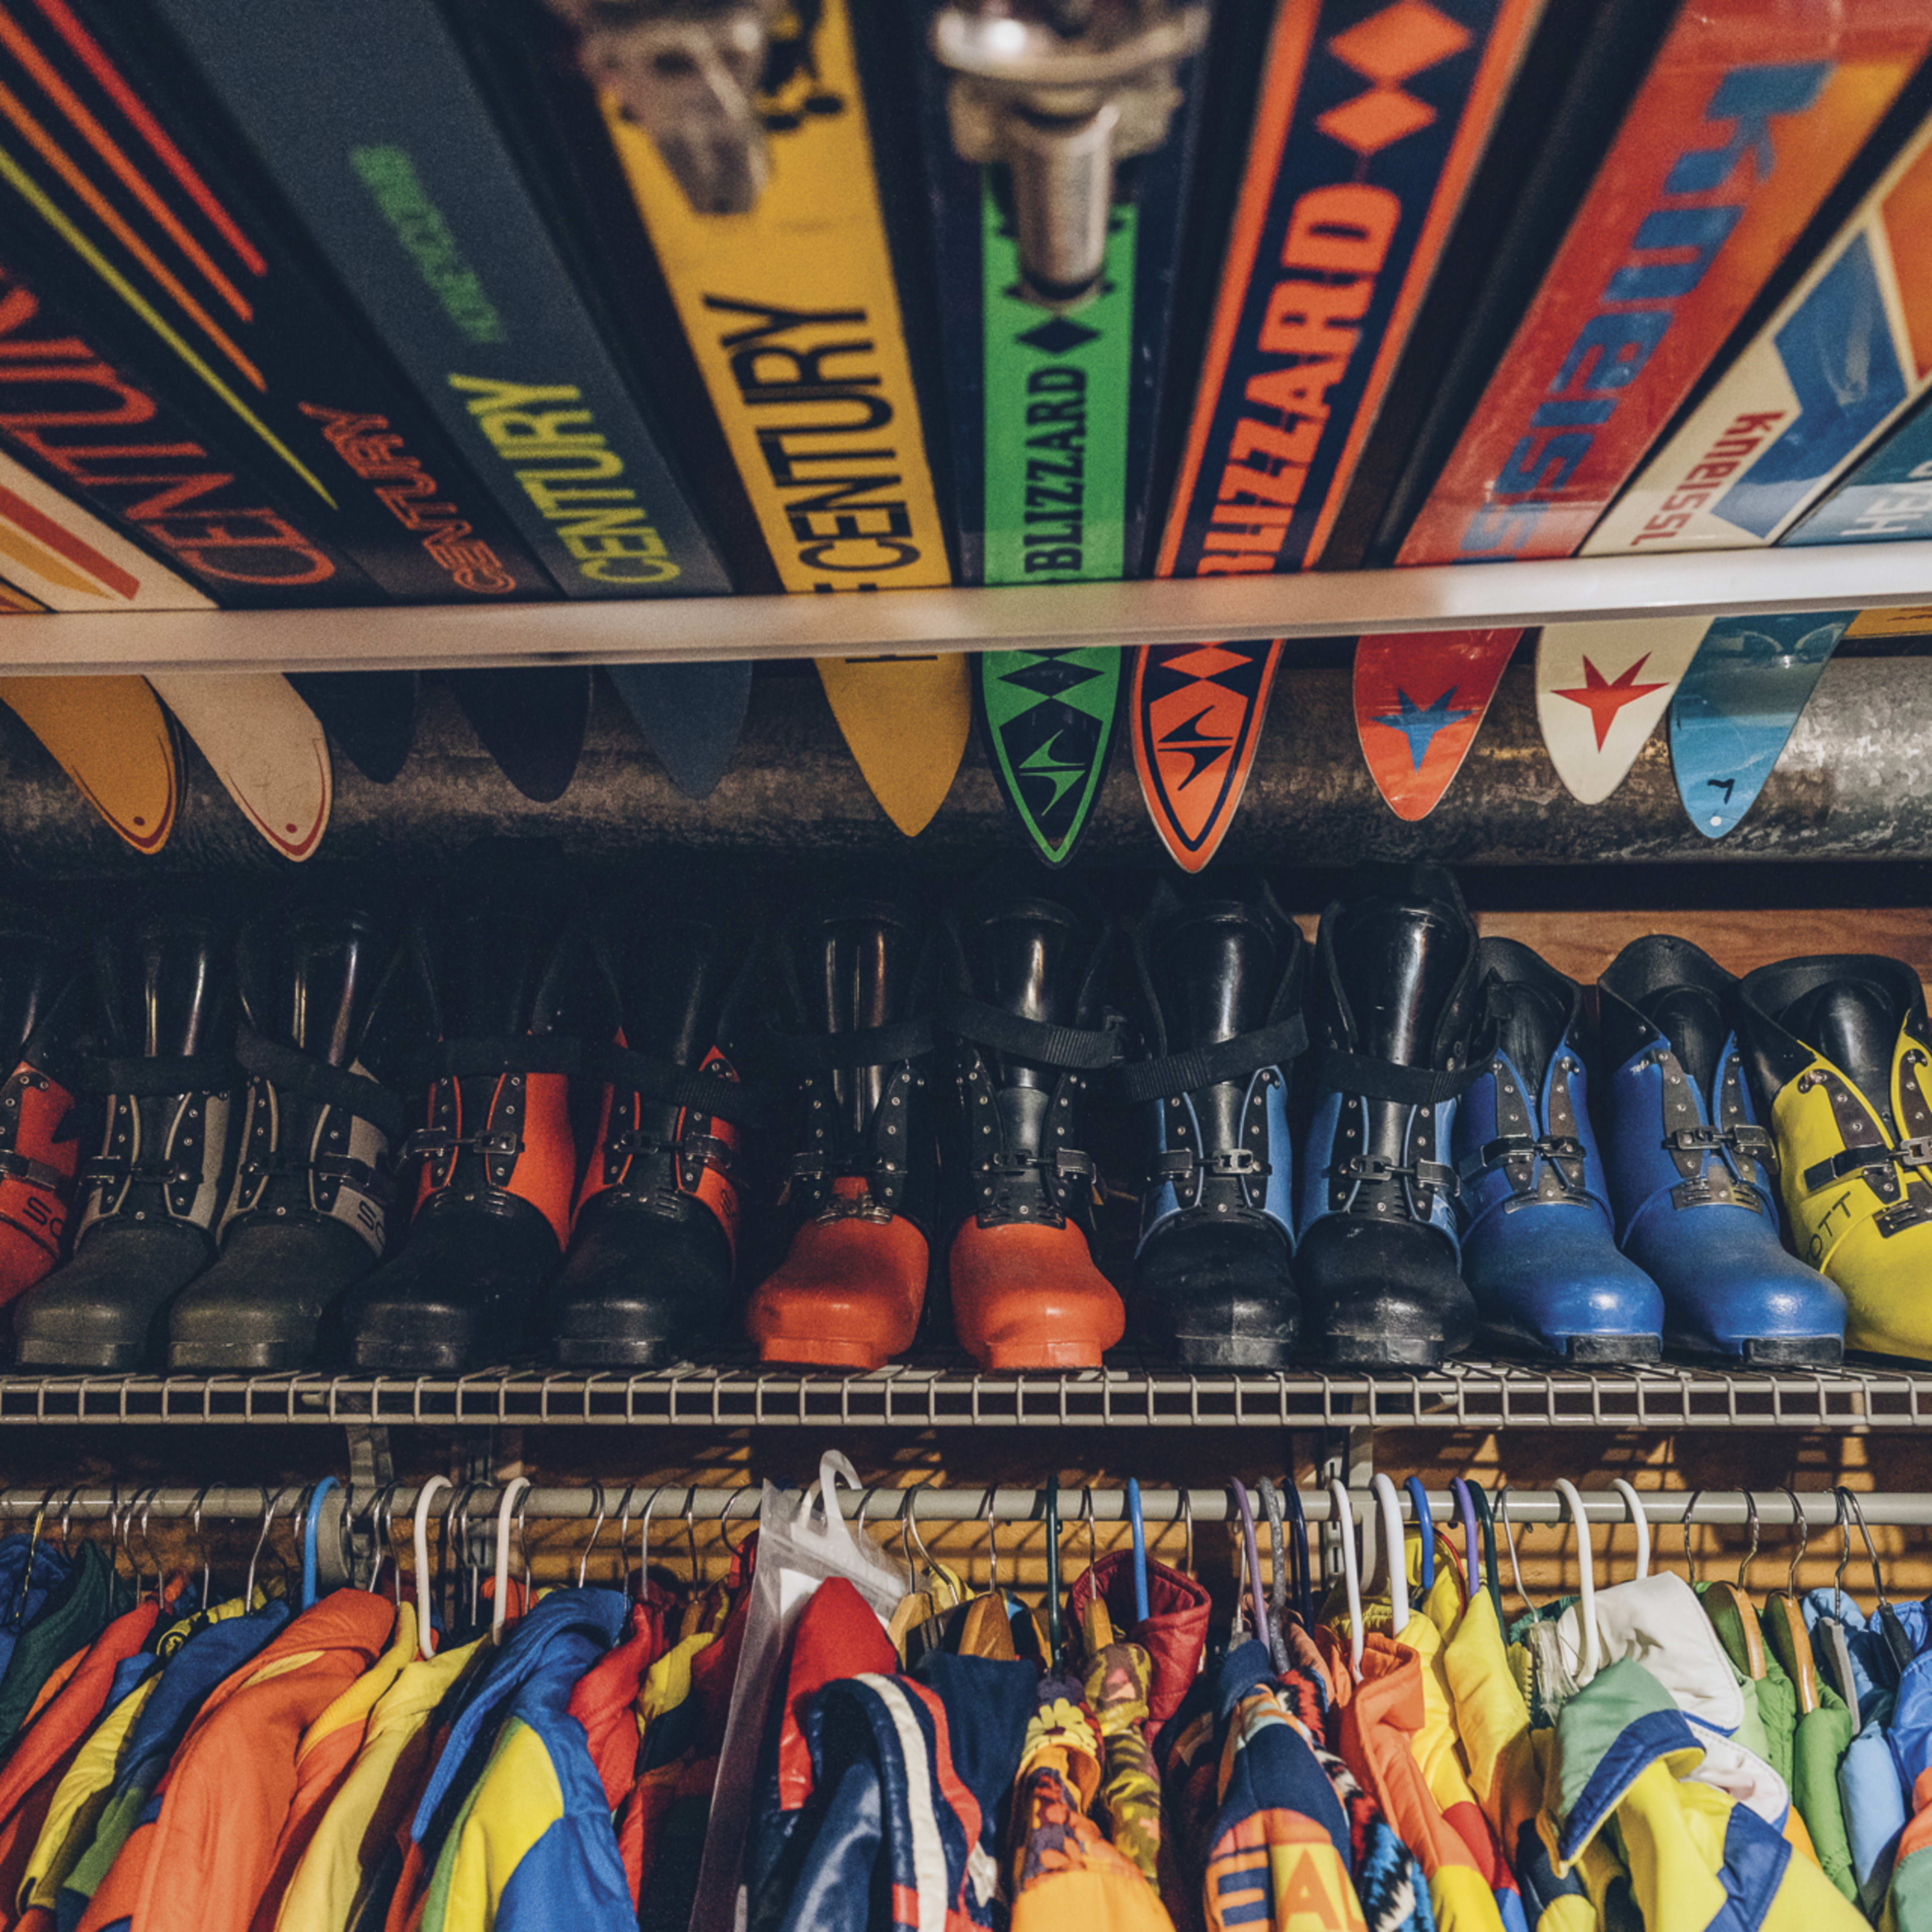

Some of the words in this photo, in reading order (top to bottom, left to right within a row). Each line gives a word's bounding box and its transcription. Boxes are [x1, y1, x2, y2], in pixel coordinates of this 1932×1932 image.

[298, 401, 516, 594] CENTURY
[448, 371, 681, 583] CENTURY
[701, 293, 922, 573] CENTURY
[1024, 367, 1087, 573] BLIZZARD
[1806, 1190, 1852, 1263] OTT
